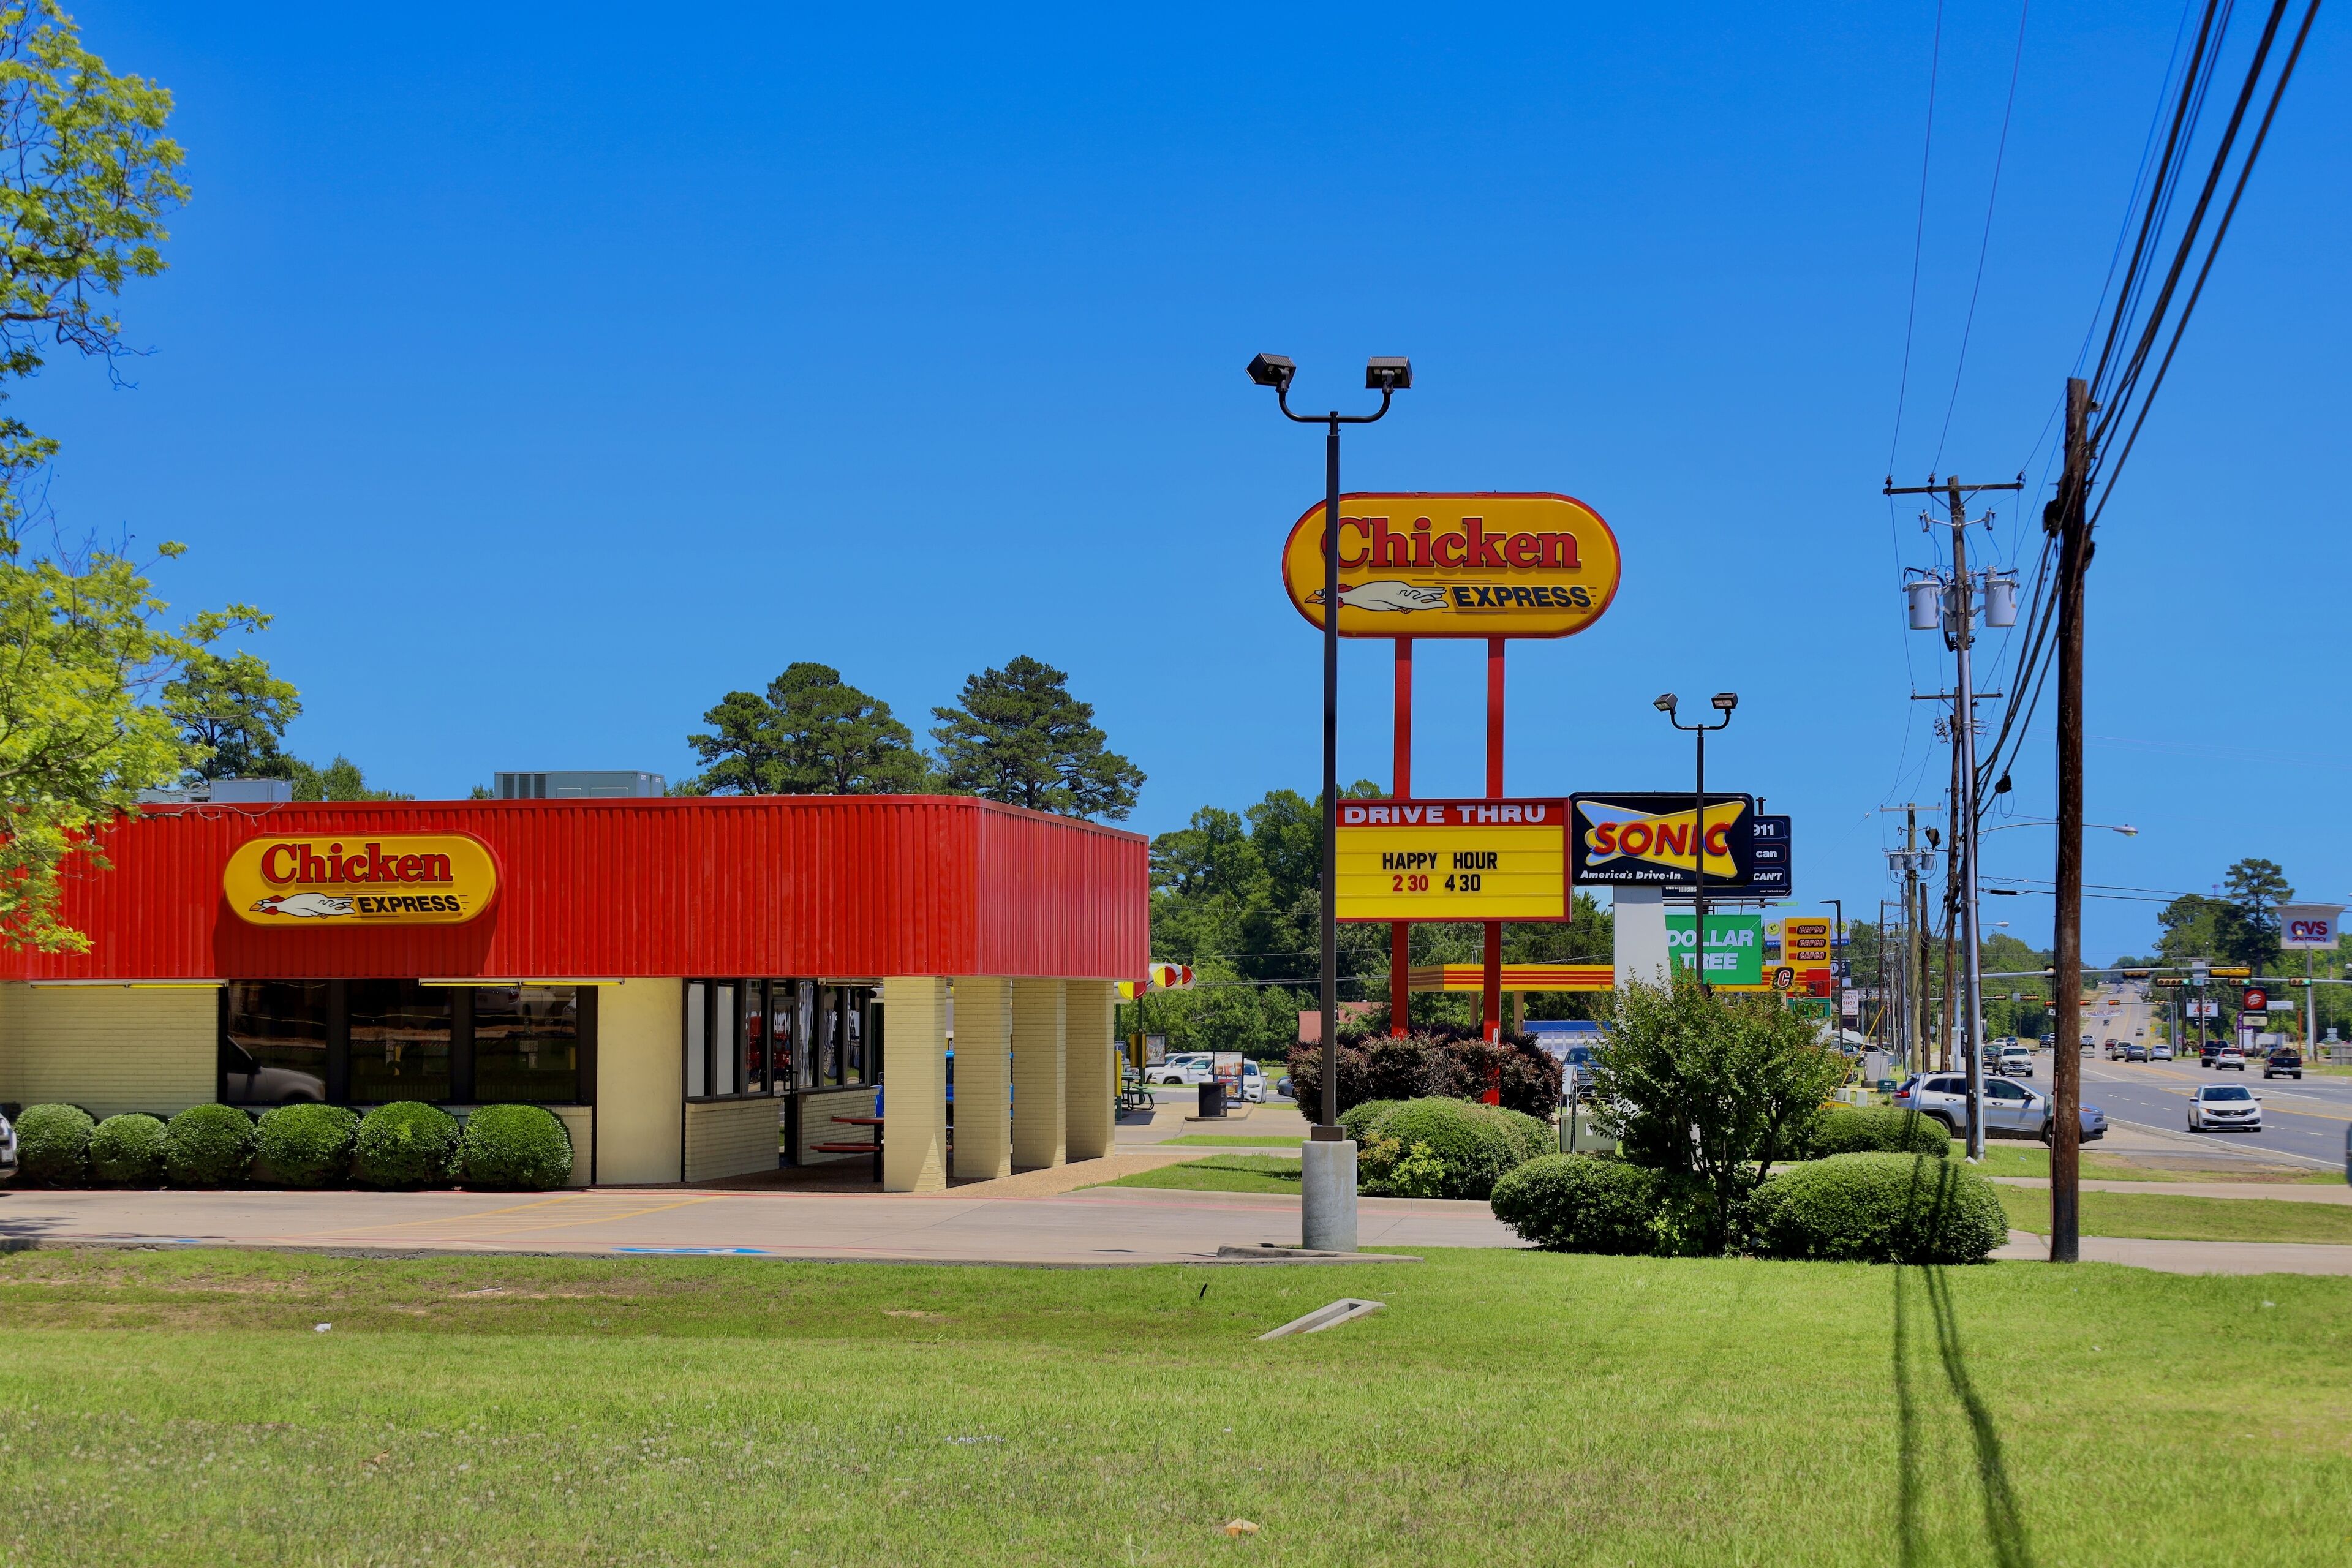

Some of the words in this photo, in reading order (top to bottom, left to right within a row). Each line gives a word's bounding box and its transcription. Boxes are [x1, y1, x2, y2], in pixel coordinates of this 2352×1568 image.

[1321, 516, 1581, 569] Chicken
[1452, 586, 1591, 608] EXPRESS
[1344, 805, 1445, 824] DRIVE
[1455, 805, 1545, 823] THRU
[1594, 821, 1732, 856] SONIC
[1754, 824, 1774, 836] 911
[261, 843, 453, 884] Chicken
[1382, 853, 1438, 870] HAPPY
[1453, 852, 1498, 869] HOUR
[1580, 870, 1634, 880] America's
[358, 895, 460, 913] EXPRESS
[2291, 921, 2328, 935] CVS
[1679, 952, 1738, 970] TREE
[1778, 970, 1790, 987] C
